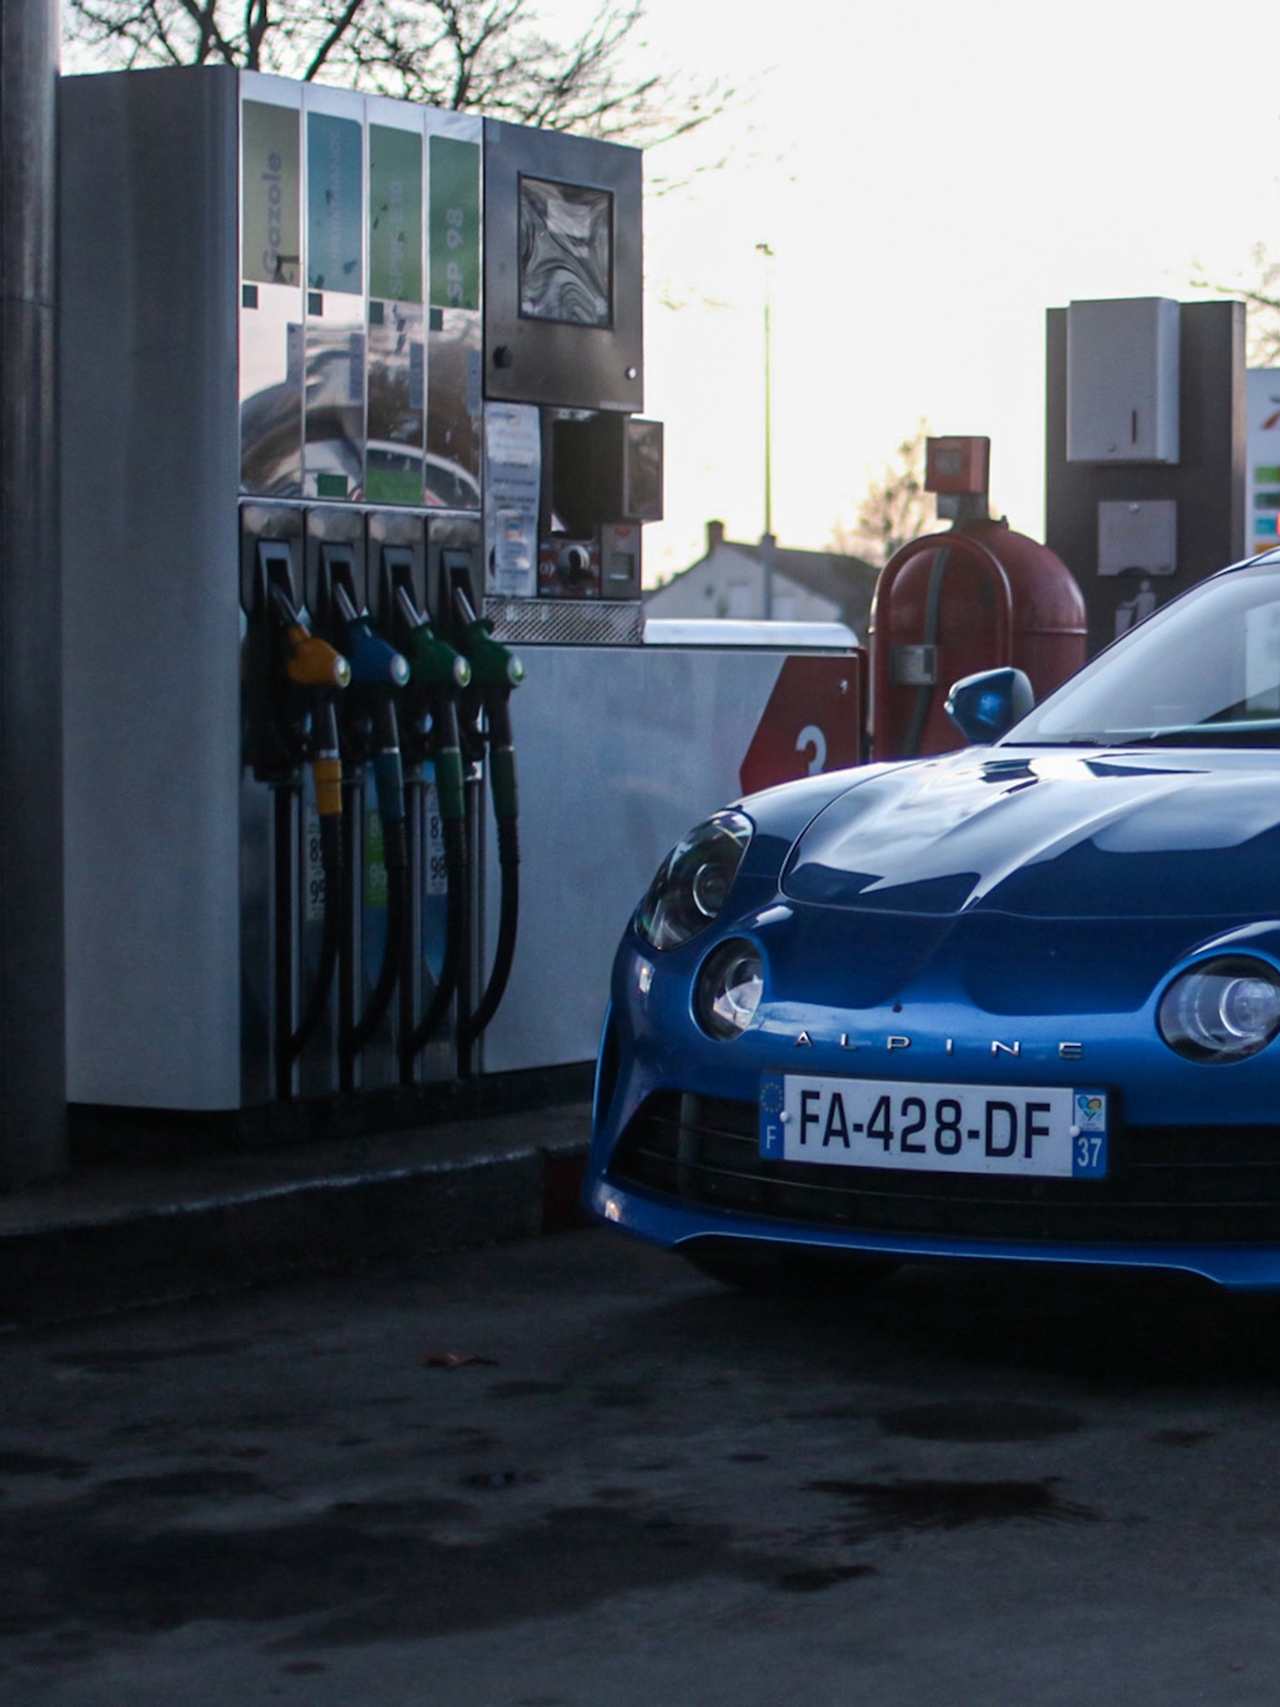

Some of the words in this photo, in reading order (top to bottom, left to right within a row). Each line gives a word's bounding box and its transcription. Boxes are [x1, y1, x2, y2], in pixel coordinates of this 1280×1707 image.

[261, 151, 282, 277] Gazole
[445, 208, 464, 251] 98
[445, 261, 464, 300] SP
[795, 1031, 1083, 1060] ALPINE
[766, 1126, 777, 1150] F
[800, 1089, 1051, 1160] FA-428-DF
[1077, 1136, 1103, 1168] 37
